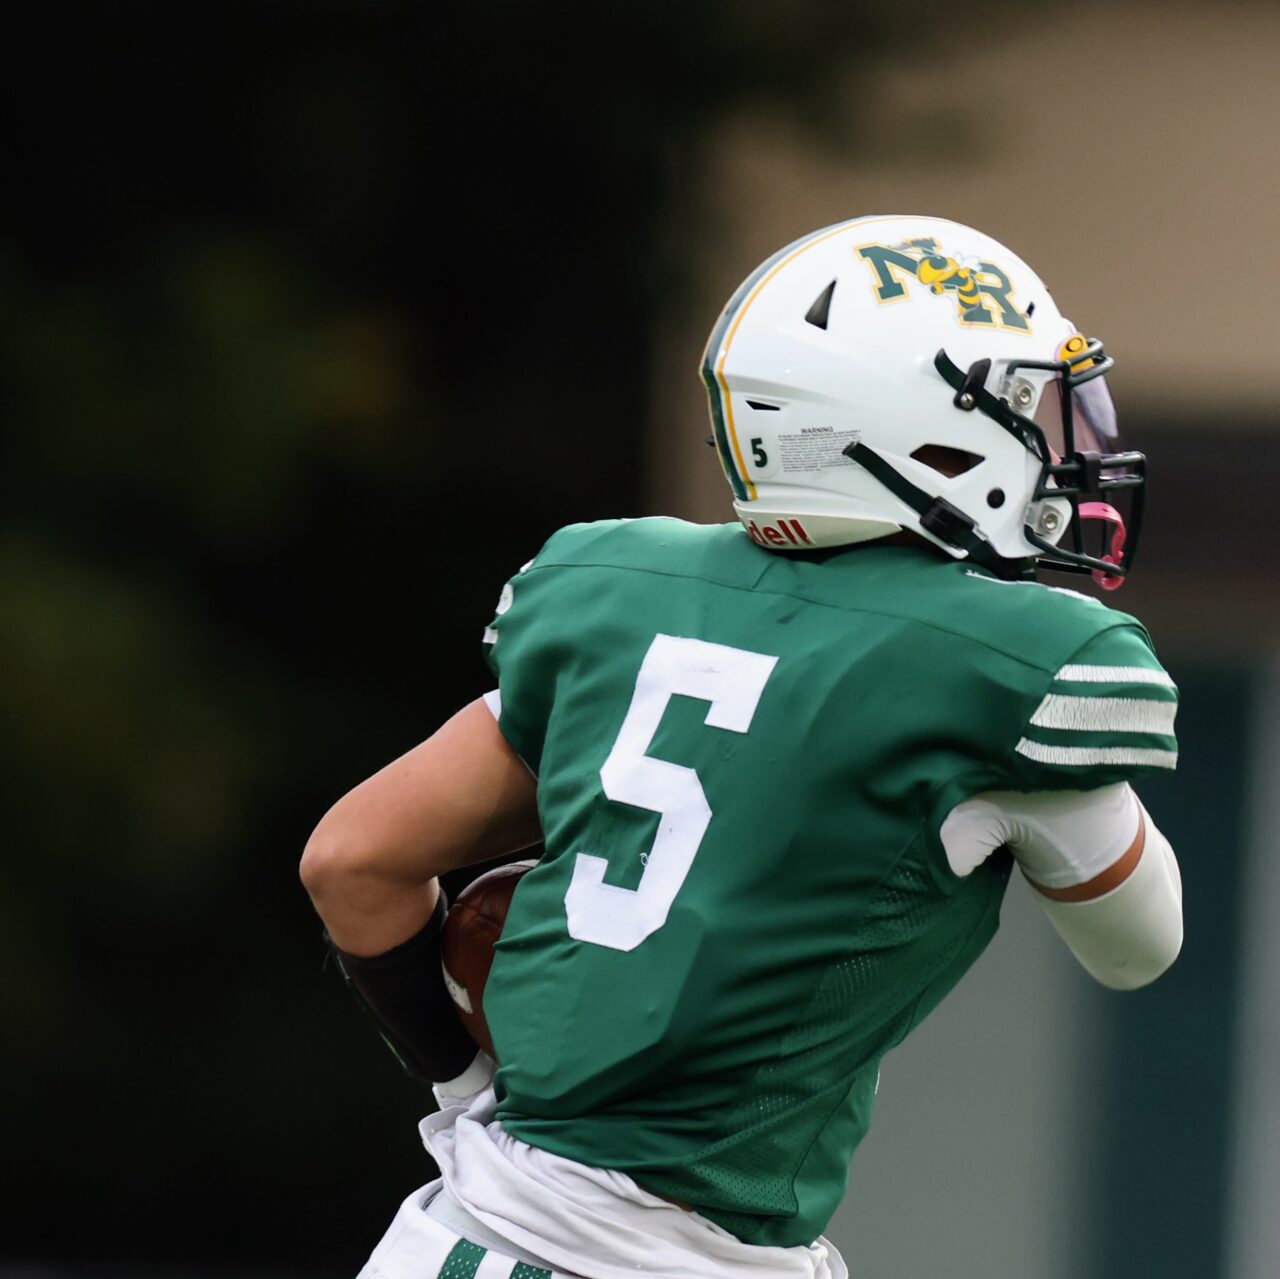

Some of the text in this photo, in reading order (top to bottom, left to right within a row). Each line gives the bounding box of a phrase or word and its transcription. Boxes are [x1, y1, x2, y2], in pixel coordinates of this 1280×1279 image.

[800, 426, 834, 434] WARNING
[750, 437, 768, 468] 5
[748, 518, 811, 545] dell
[563, 633, 780, 953] 5
